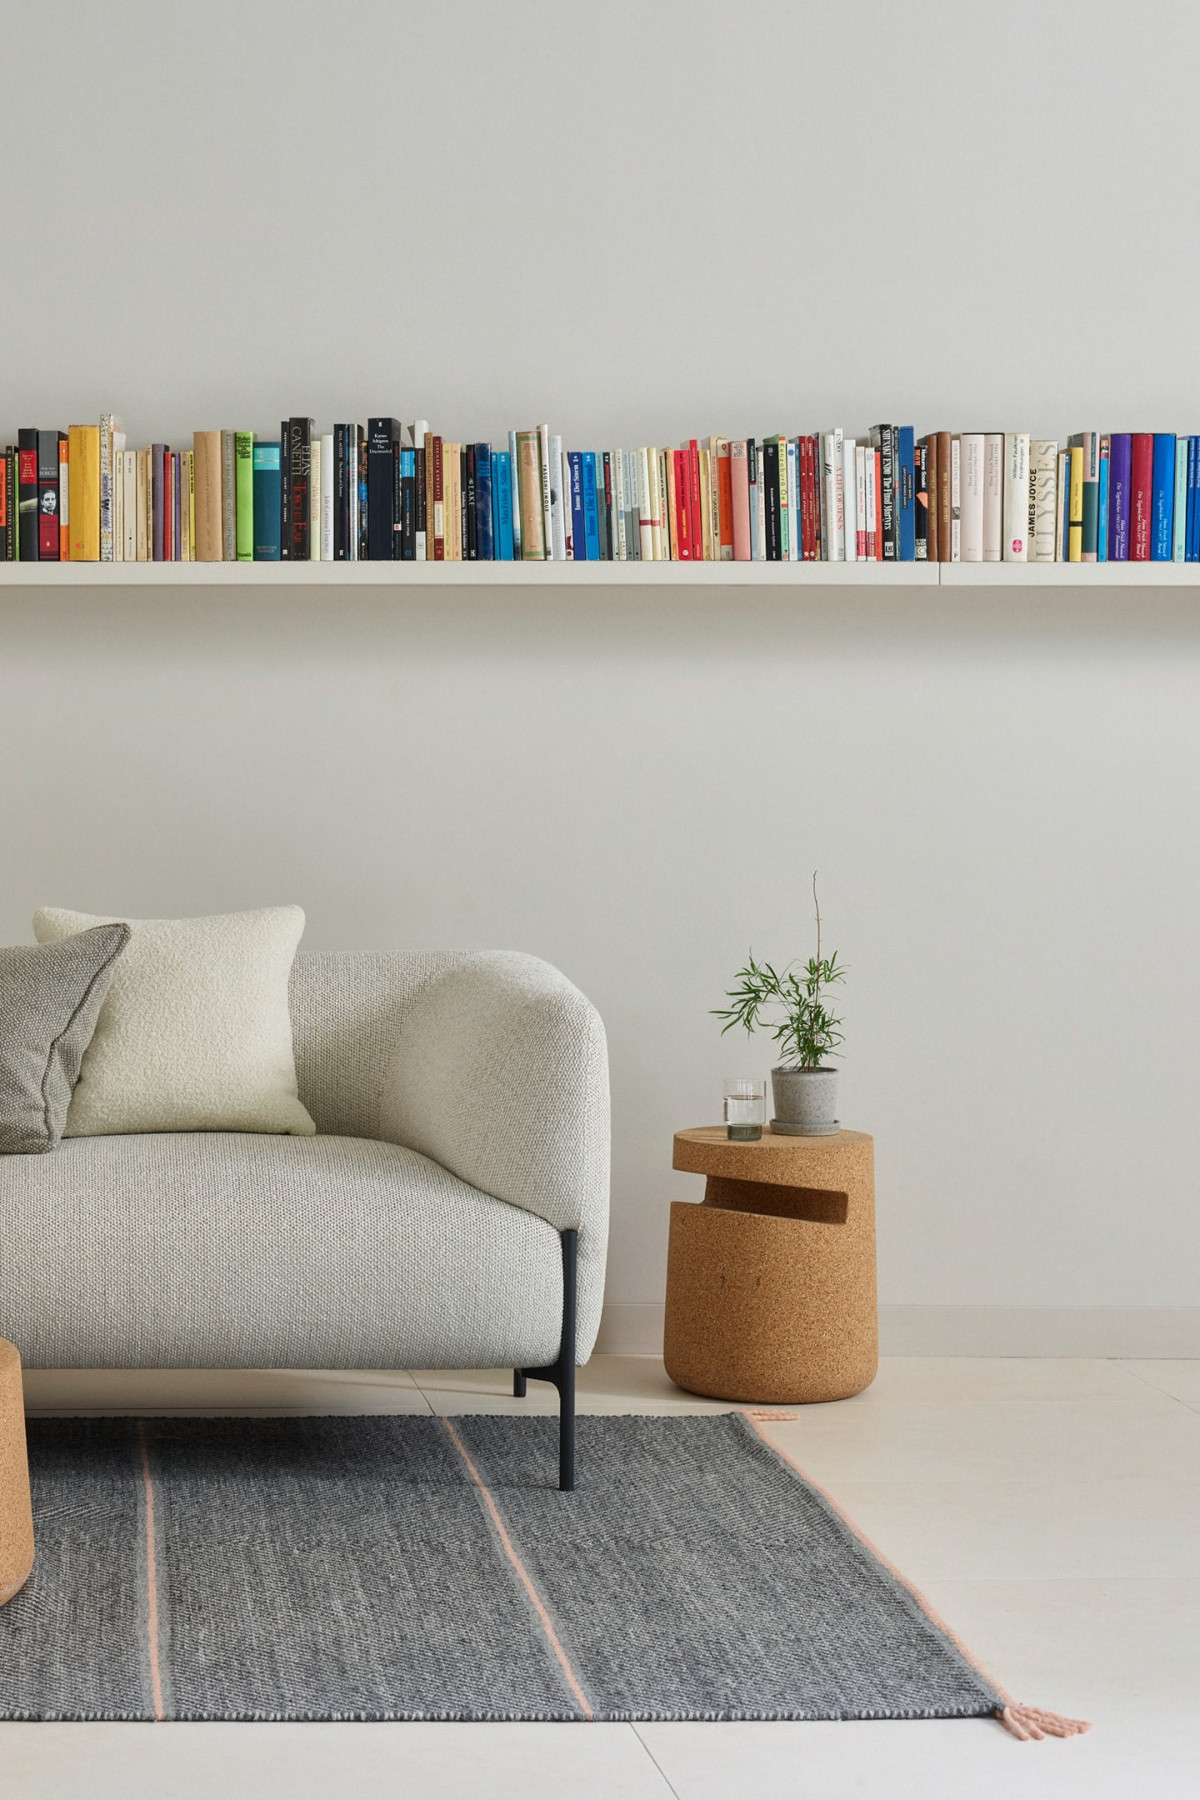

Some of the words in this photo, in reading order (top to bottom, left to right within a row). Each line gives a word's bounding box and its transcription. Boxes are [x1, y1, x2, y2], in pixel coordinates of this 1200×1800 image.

[291, 426, 301, 475] CANETTI
[301, 445, 311, 476] ELIAS
[586, 464, 594, 496] Eiswand
[883, 477, 891, 488] The
[1028, 468, 1037, 501] JOYCE
[587, 496, 595, 511] Die
[836, 493, 842, 502] OF
[884, 489, 892, 504] Final
[1035, 444, 1057, 557] ULYSSES
[588, 516, 596, 536] Inoue
[882, 505, 892, 530] Martyrs
[1028, 503, 1036, 538] JAMES
